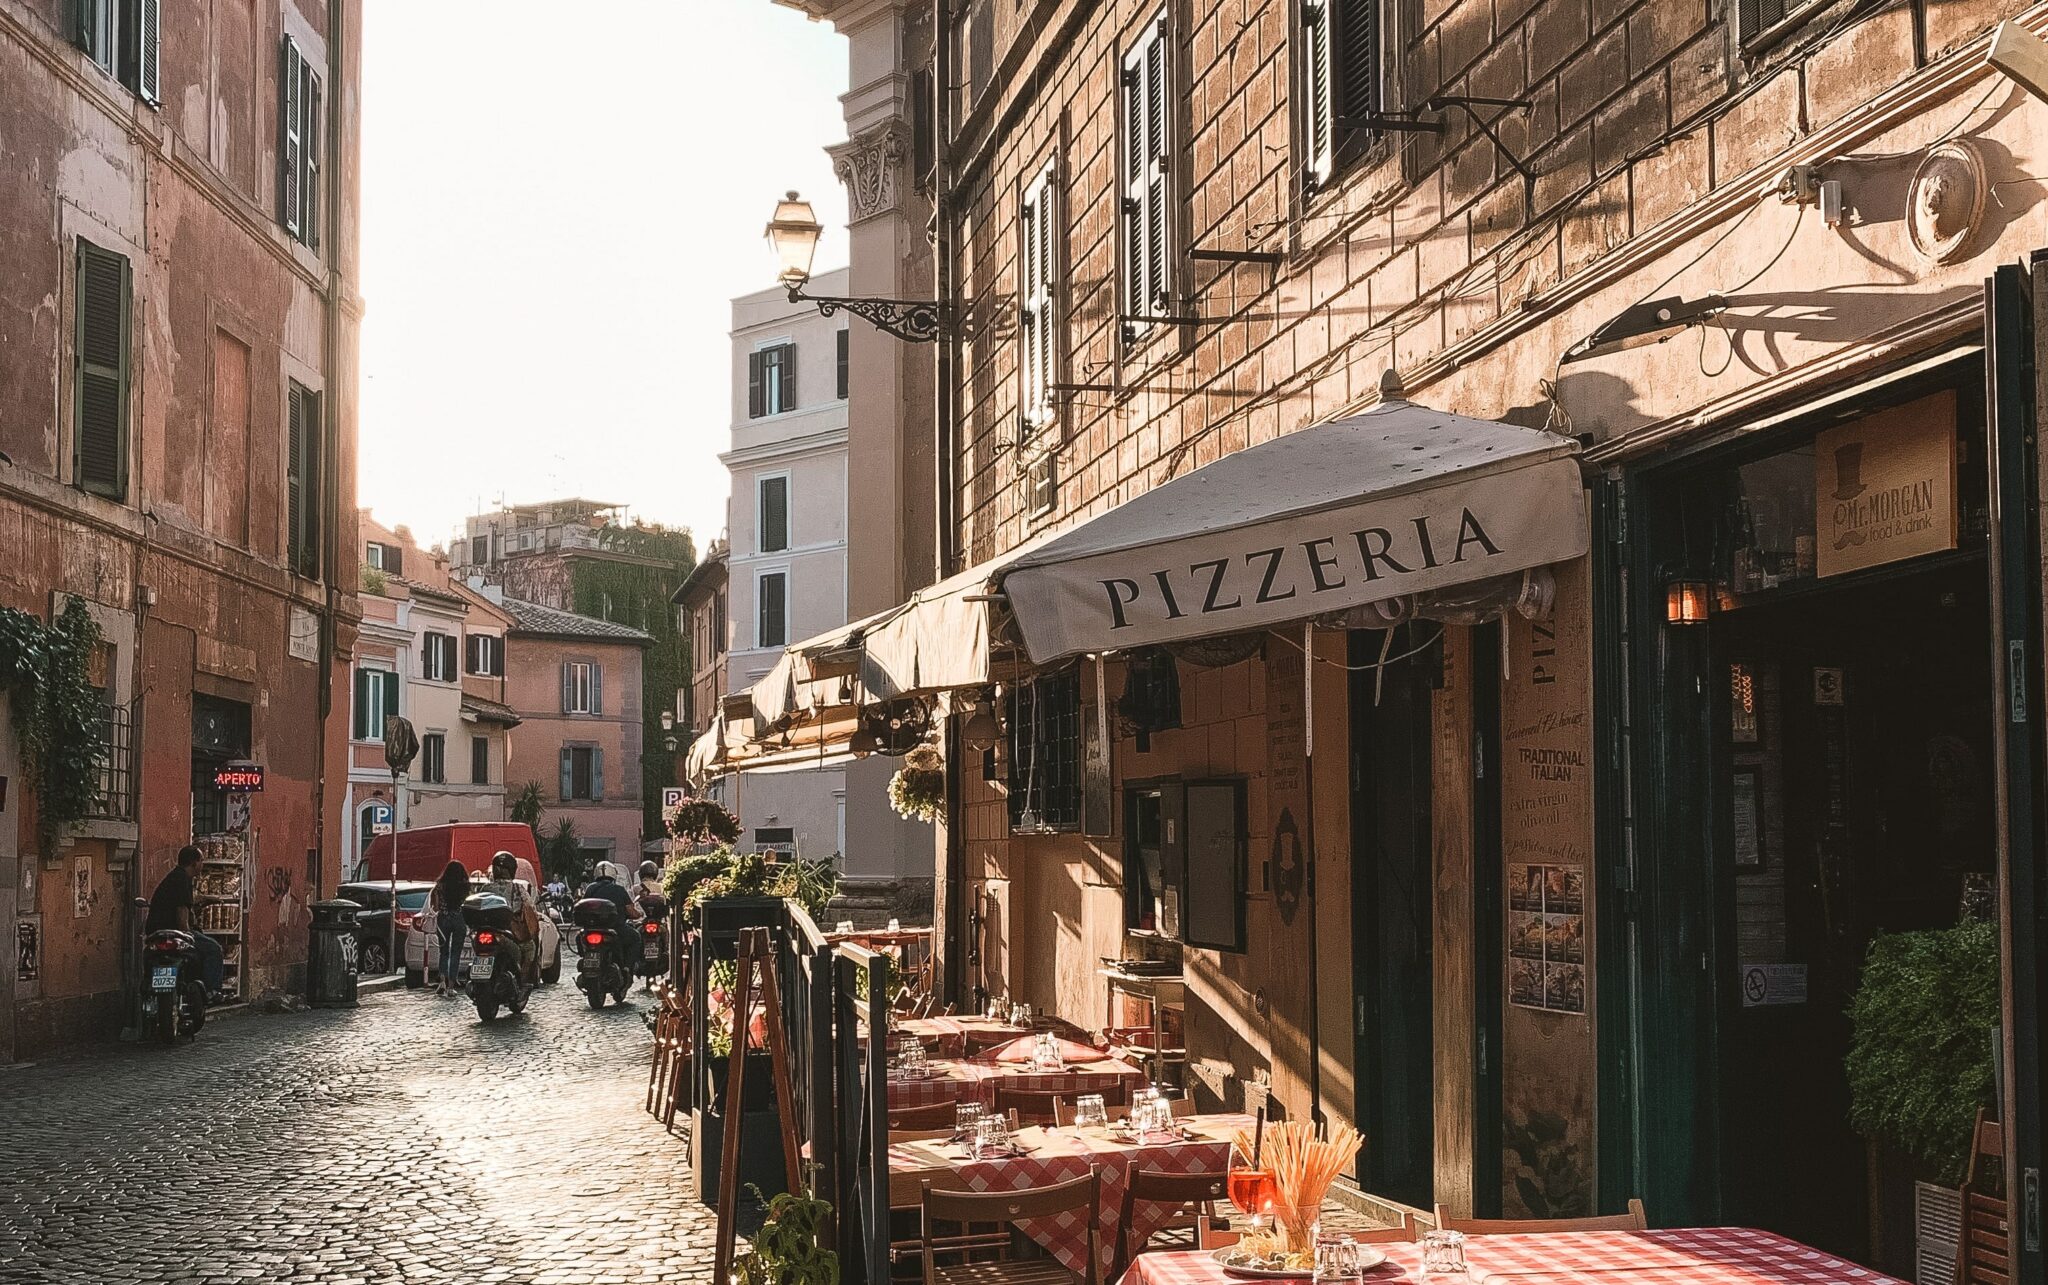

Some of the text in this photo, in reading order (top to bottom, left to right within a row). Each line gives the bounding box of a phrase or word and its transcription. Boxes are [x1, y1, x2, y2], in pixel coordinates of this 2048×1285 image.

[1870, 513, 1933, 542] food & drink
[1097, 507, 1505, 629] PIZZERIA
[1519, 748, 1585, 767] TRADITIONAL
[216, 773, 261, 785] APERTO
[1531, 764, 1572, 782] ITALIAN
[668, 792, 679, 805] P
[1538, 792, 1569, 807] virgin
[376, 807, 389, 823] P
[1547, 809, 1560, 824] oil
